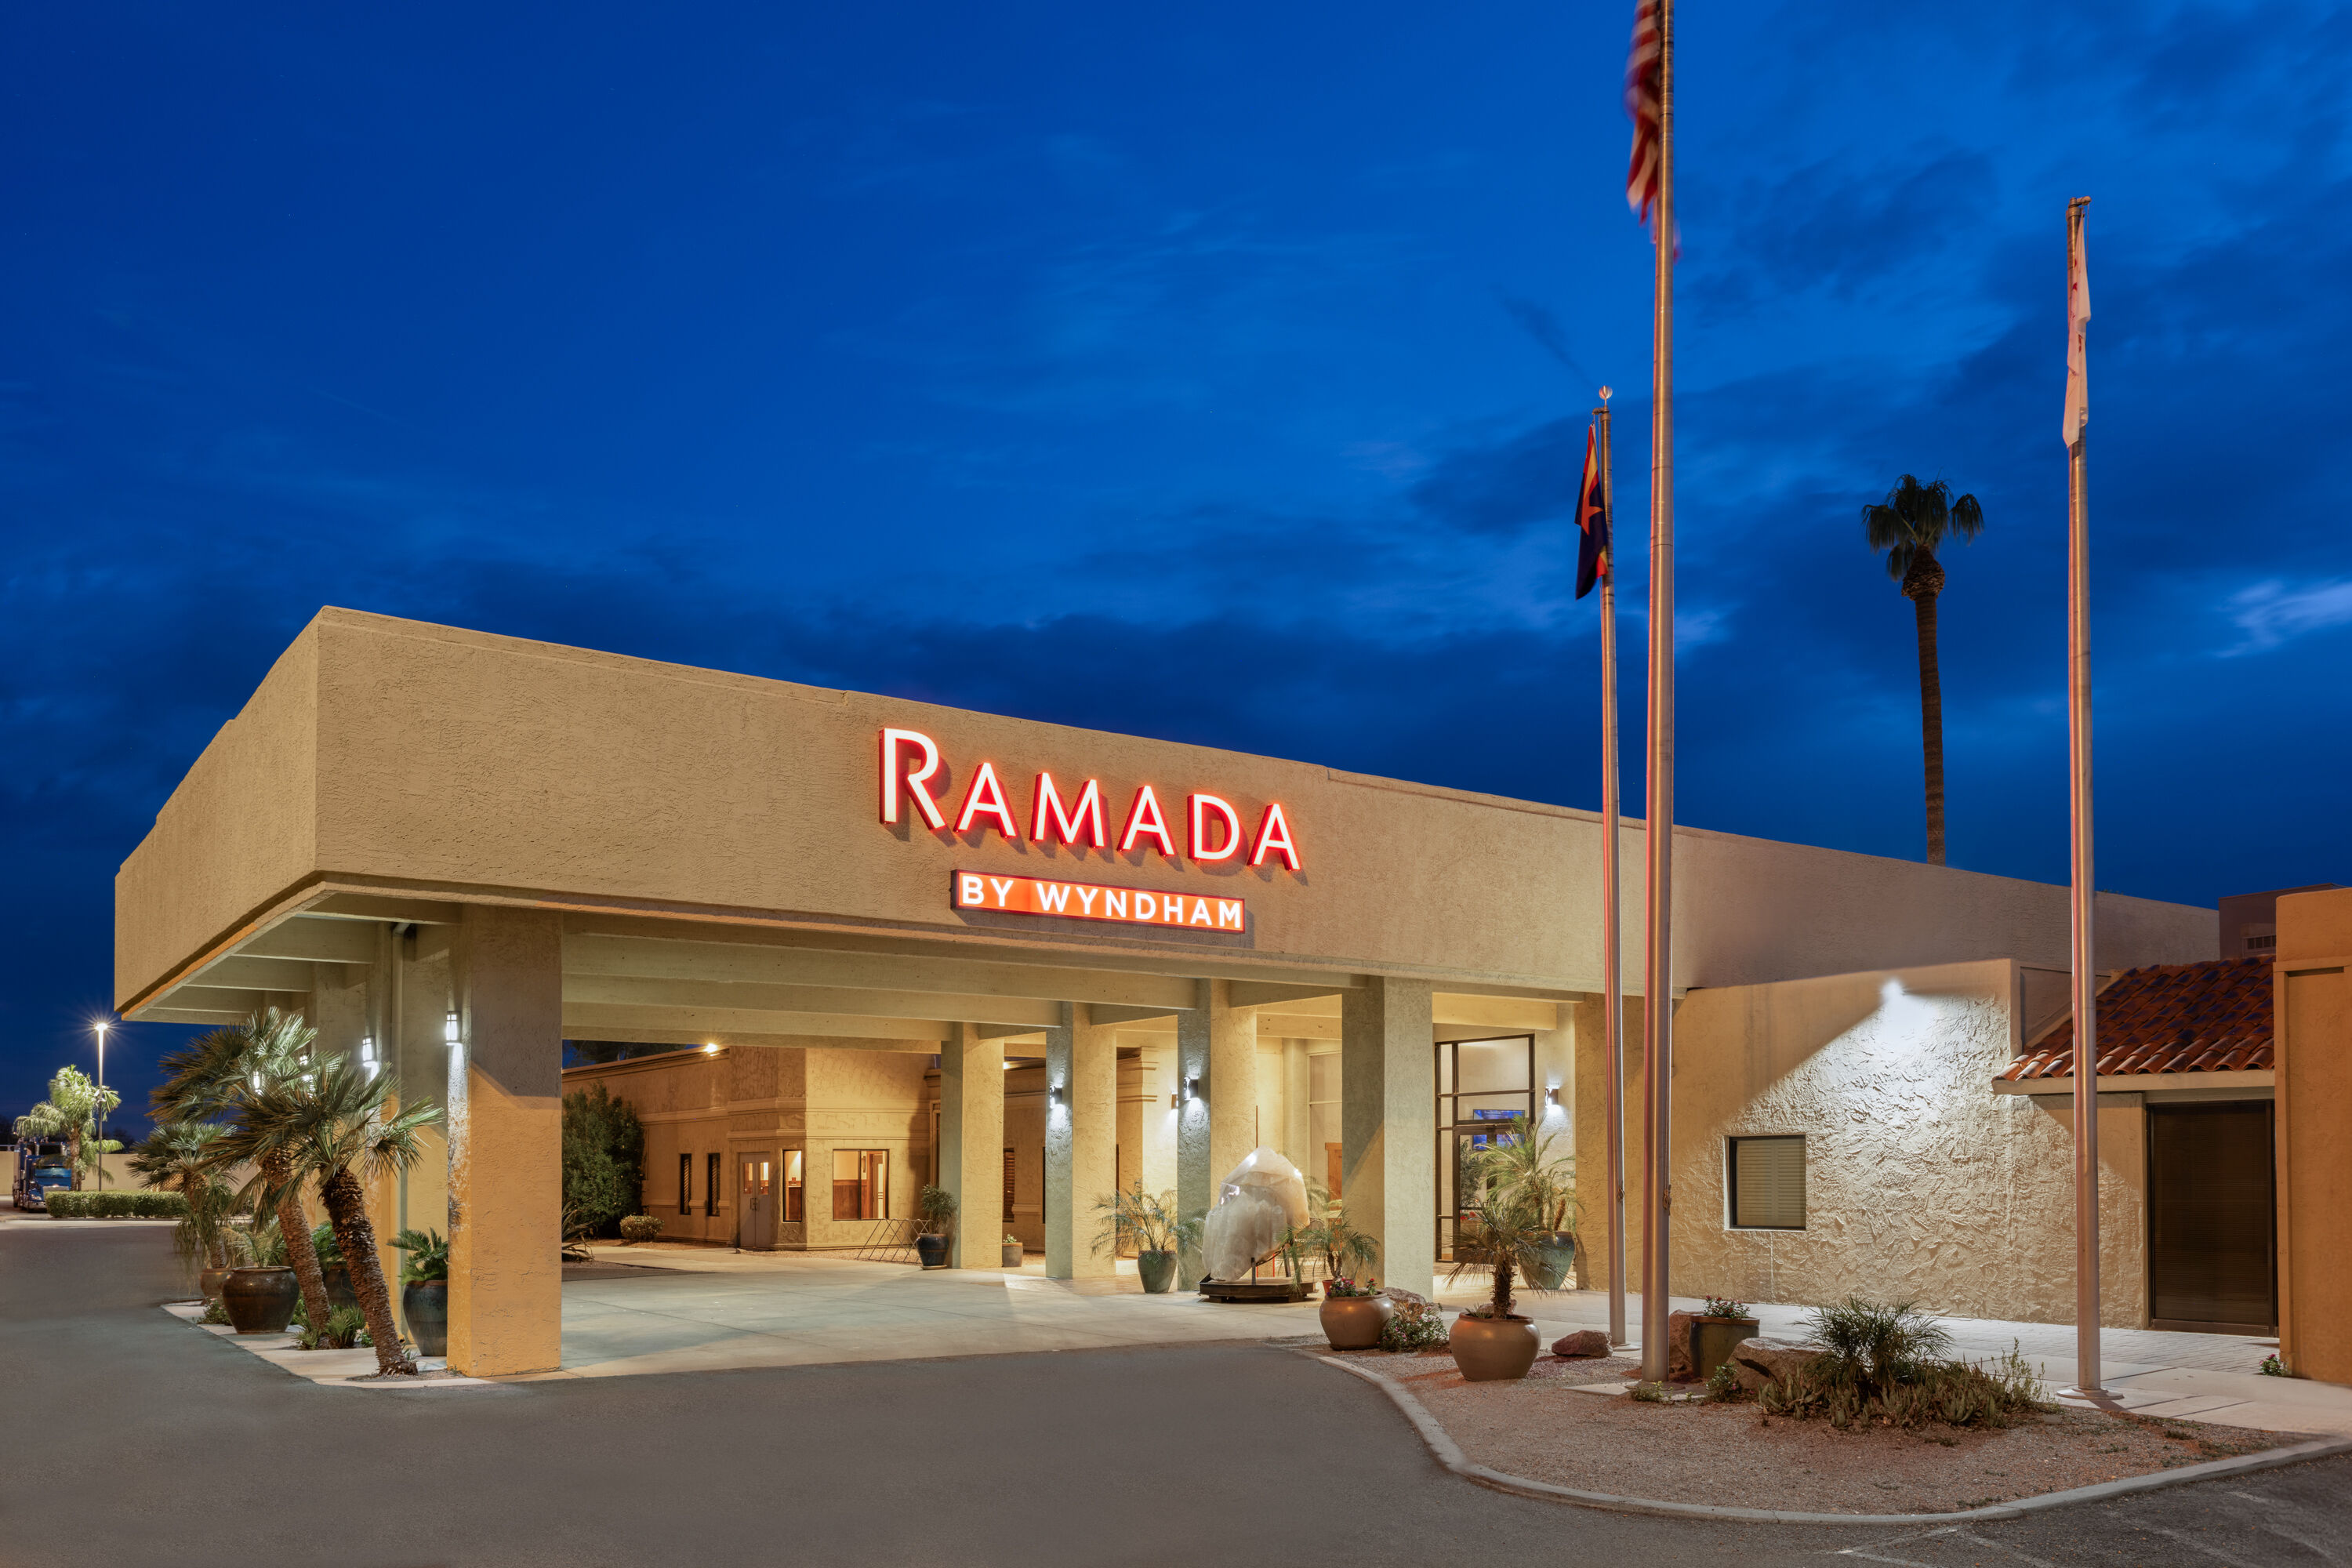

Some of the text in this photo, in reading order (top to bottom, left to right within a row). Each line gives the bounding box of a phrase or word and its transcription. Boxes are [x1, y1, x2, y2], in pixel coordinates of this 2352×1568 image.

[879, 728, 1301, 871] RAMADA
[962, 876, 1241, 929] BY WYNDHAM
